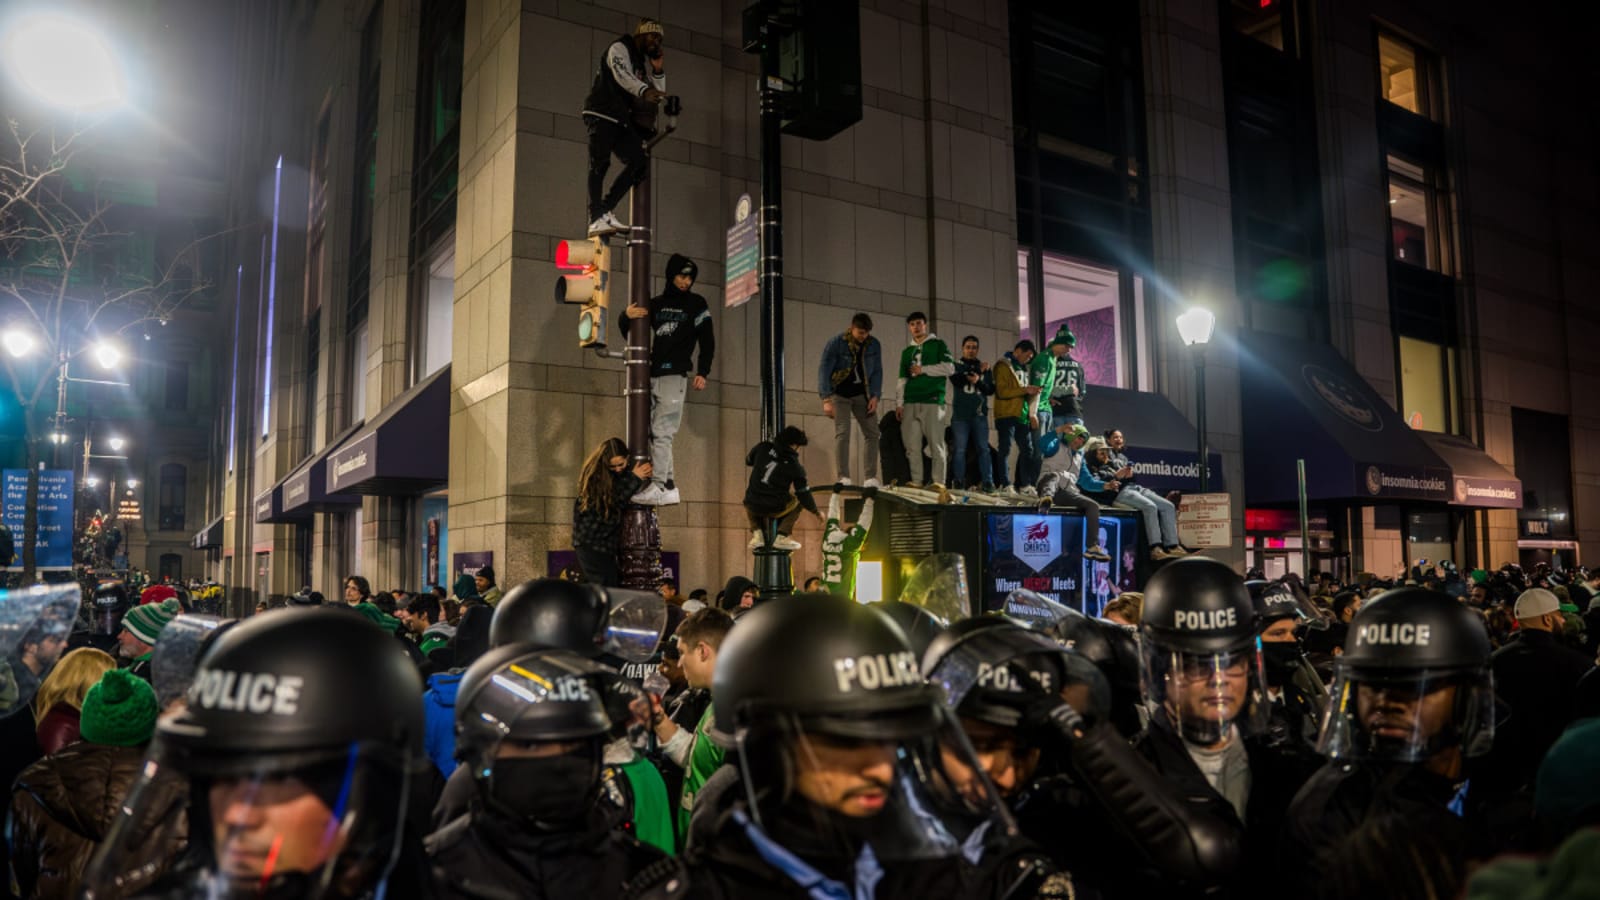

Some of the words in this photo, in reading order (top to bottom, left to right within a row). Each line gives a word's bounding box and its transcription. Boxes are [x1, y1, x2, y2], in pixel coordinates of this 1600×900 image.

[1056, 370, 1077, 388] 26
[761, 460, 777, 485] 1
[1172, 462, 1211, 479] cookis
[1382, 473, 1418, 488] insomnia
[1419, 475, 1446, 491] cookies
[1467, 484, 1495, 497] insomnia
[1495, 486, 1516, 500] cookies
[995, 578, 1022, 592] Where
[1052, 577, 1076, 590] Meets
[1264, 593, 1297, 607] POLI
[1174, 607, 1237, 630] POLICE
[1355, 623, 1431, 647] POLICE
[188, 667, 304, 715] POLICE
[547, 676, 591, 702] LICE
